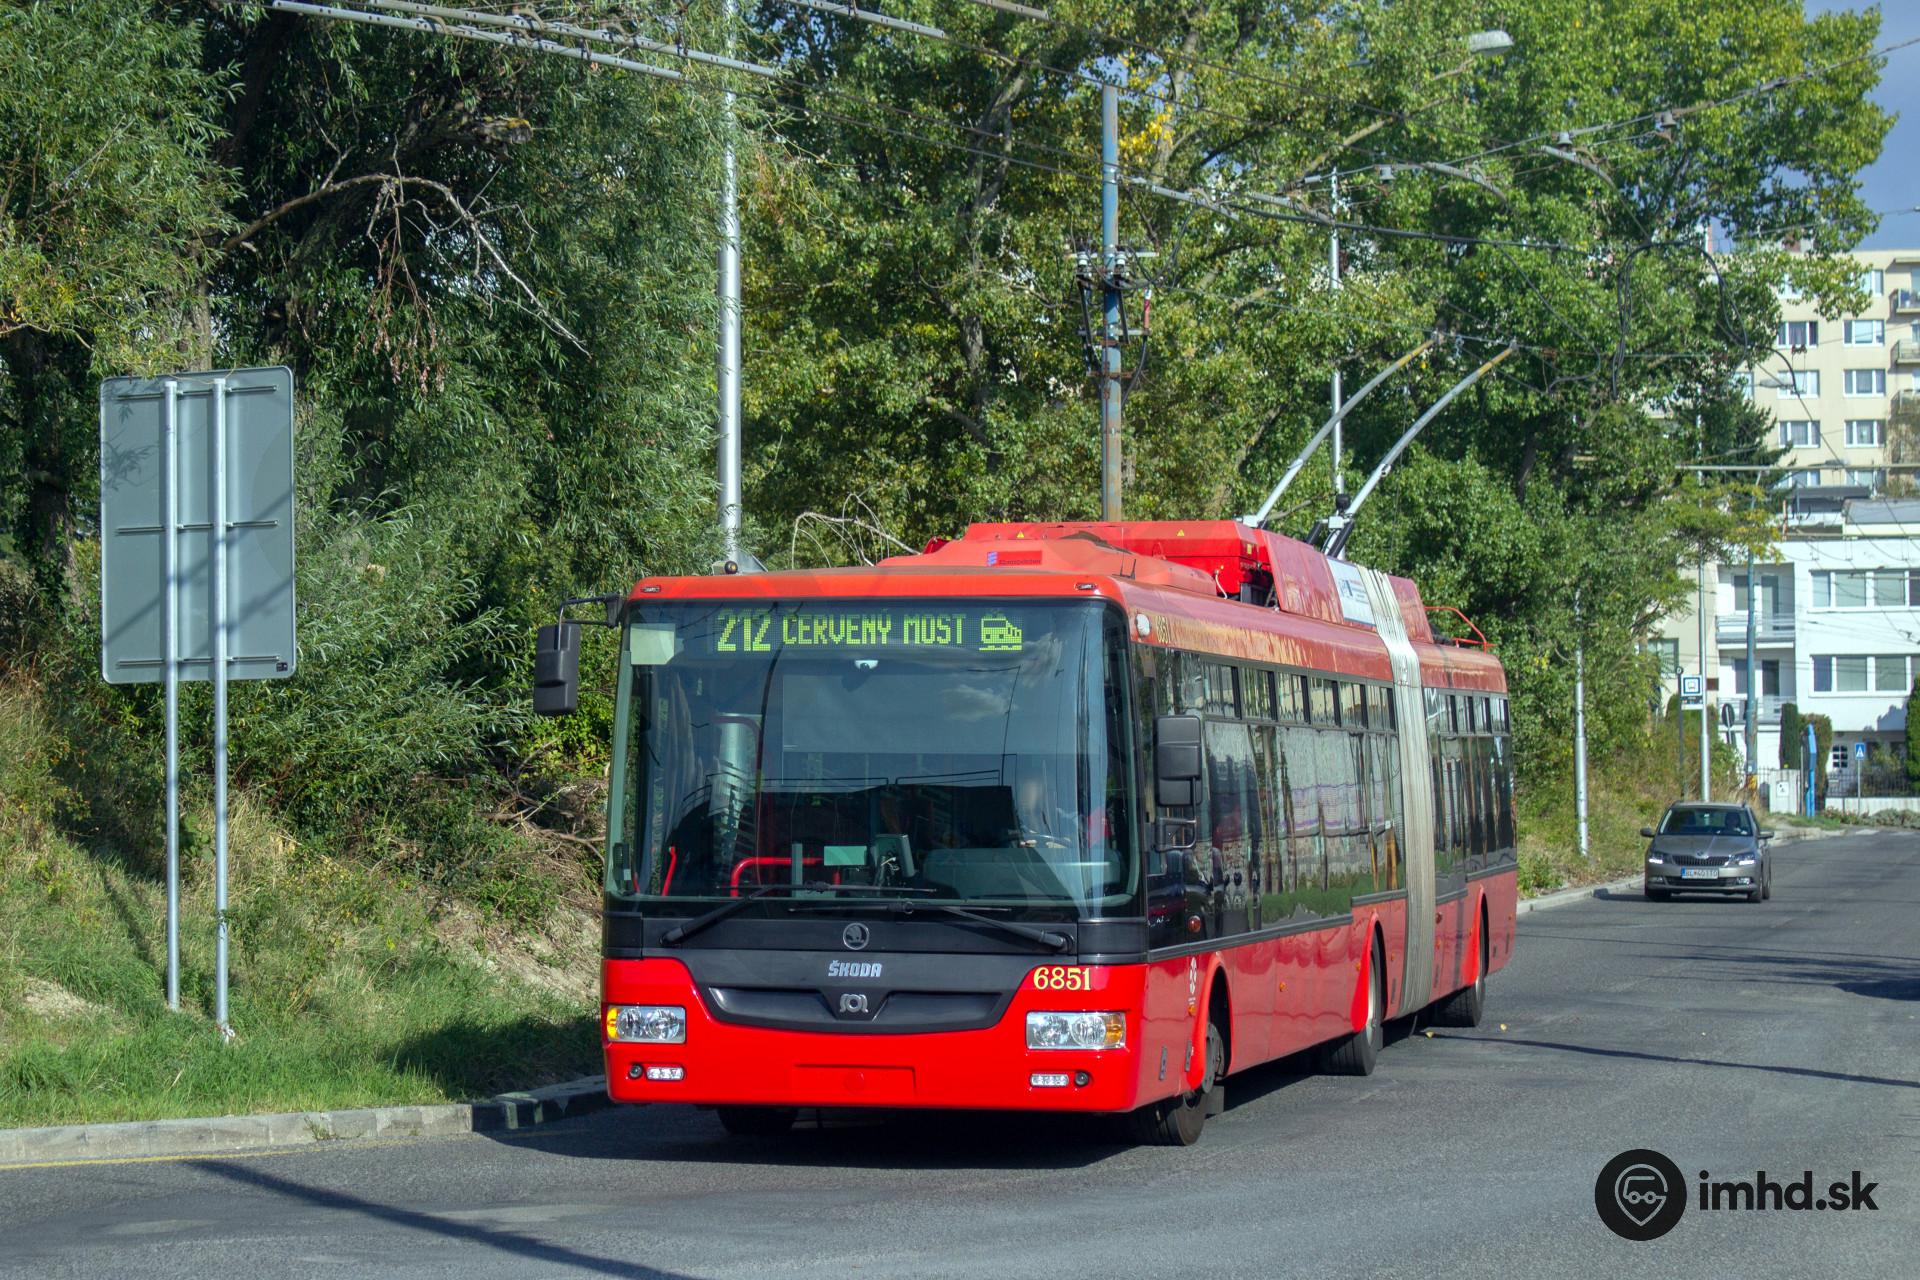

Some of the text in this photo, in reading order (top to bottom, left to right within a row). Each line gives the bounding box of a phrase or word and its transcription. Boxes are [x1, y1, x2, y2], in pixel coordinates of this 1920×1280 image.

[717, 609, 771, 651] 212
[904, 613, 967, 645] MOST
[828, 960, 882, 977] ŠKODA
[1033, 967, 1091, 991] 6851
